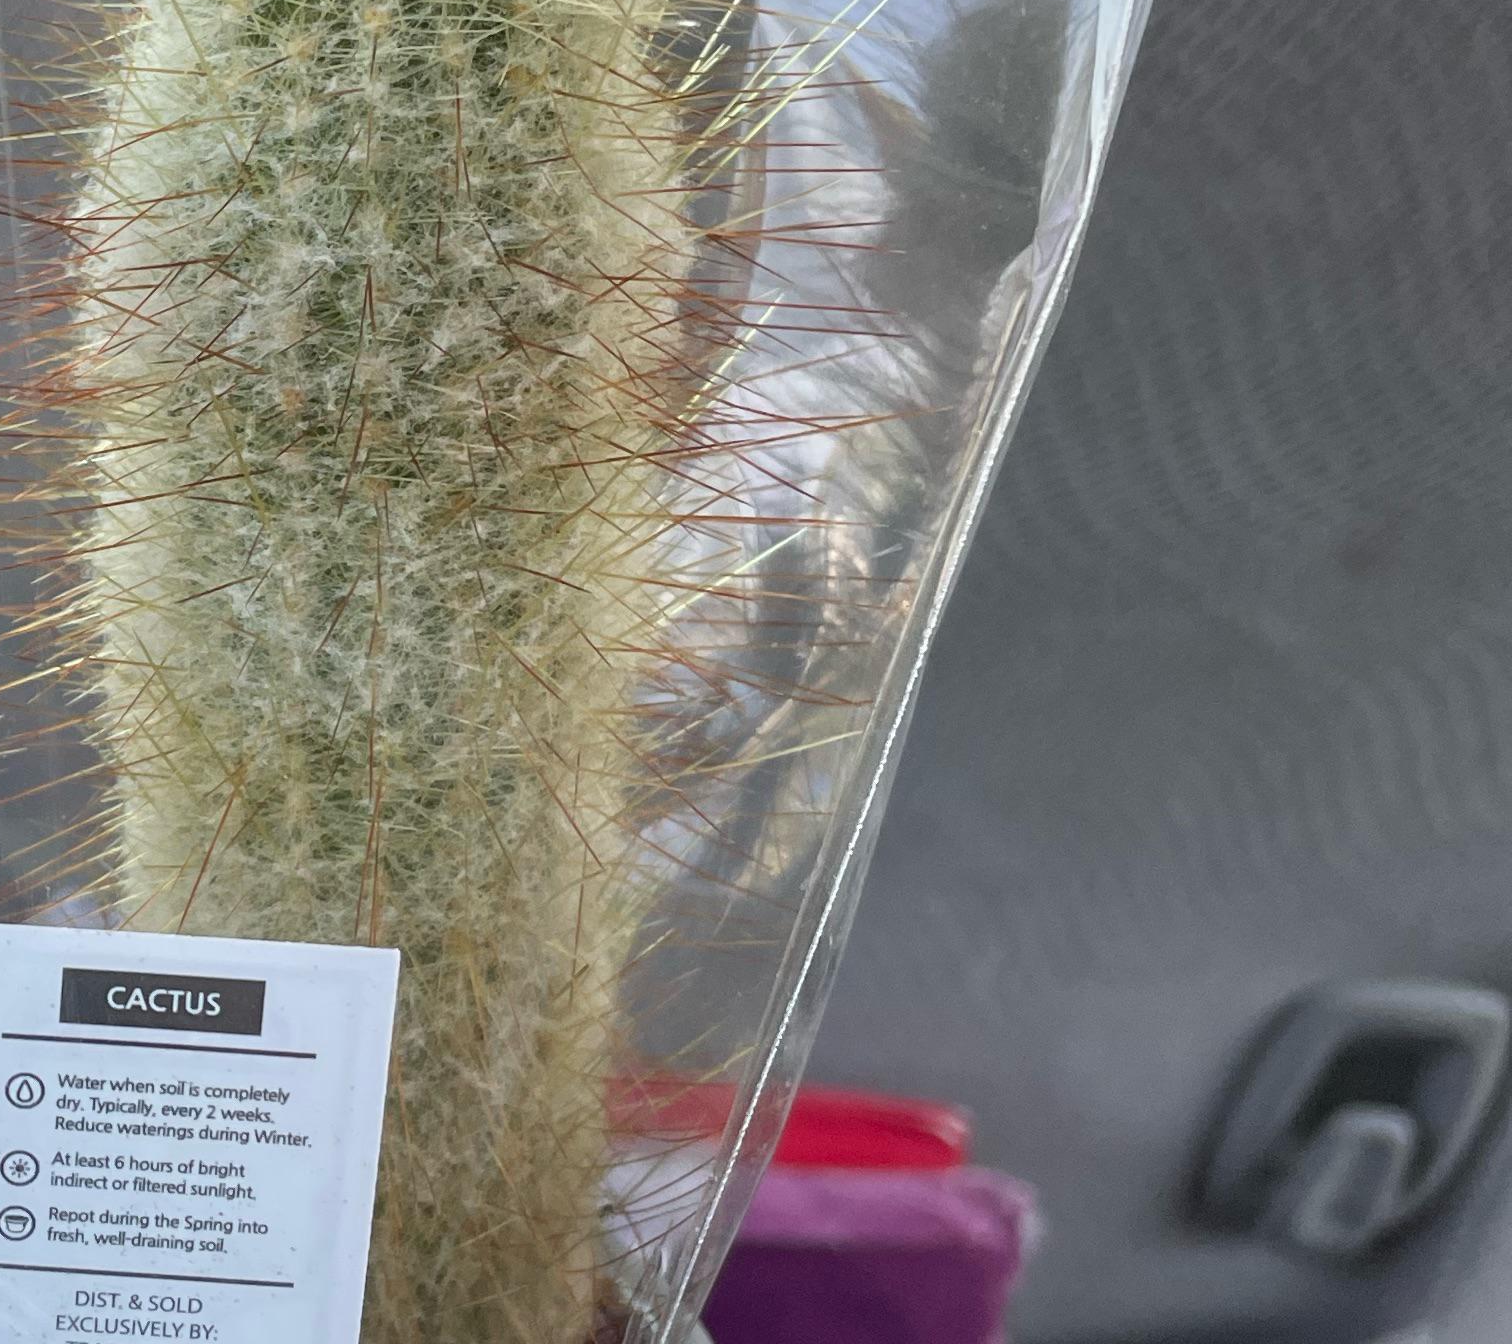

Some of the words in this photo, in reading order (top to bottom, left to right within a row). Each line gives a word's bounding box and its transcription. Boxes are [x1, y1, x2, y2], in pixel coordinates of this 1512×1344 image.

[106, 985, 222, 1016] CACTUS
[57, 1073, 106, 1092] Water
[110, 1079, 155, 1095] when
[159, 1080, 186, 1096] soil
[188, 1082, 200, 1098] is
[204, 1084, 289, 1105] completely
[56, 1094, 85, 1112] dry.
[91, 1097, 156, 1117] Typically,
[161, 1106, 202, 1121] every
[206, 1104, 216, 1119] 2
[221, 1106, 274, 1124] weeks.
[55, 1116, 113, 1134] Reduce
[117, 1122, 194, 1140] waterings
[198, 1124, 250, 1145] during
[254, 1129, 312, 1148] Winter.
[51, 1152, 71, 1166] At
[74, 1152, 111, 1169] least
[114, 1155, 125, 1170] 6
[129, 1156, 173, 1173] hours
[177, 1158, 195, 1175] of
[198, 1160, 246, 1179] bright
[50, 1172, 108, 1190] indirect
[112, 1179, 129, 1191] or
[132, 1176, 186, 1195] filtered
[190, 1181, 256, 1201] sunlight.
[48, 1207, 95, 1225] Repot
[99, 1210, 149, 1229] during
[154, 1211, 180, 1229] the
[184, 1215, 234, 1235] Spring
[237, 1219, 269, 1235] into
[47, 1226, 89, 1246] fresh,
[93, 1230, 195, 1253] well-draining
[199, 1238, 228, 1254] soil.
[75, 1290, 123, 1310] DIST.
[128, 1294, 143, 1310] &
[147, 1295, 203, 1314] SOLD
[55, 1314, 184, 1338] EXCLUSIVELY
[189, 1323, 218, 1342] BY:
